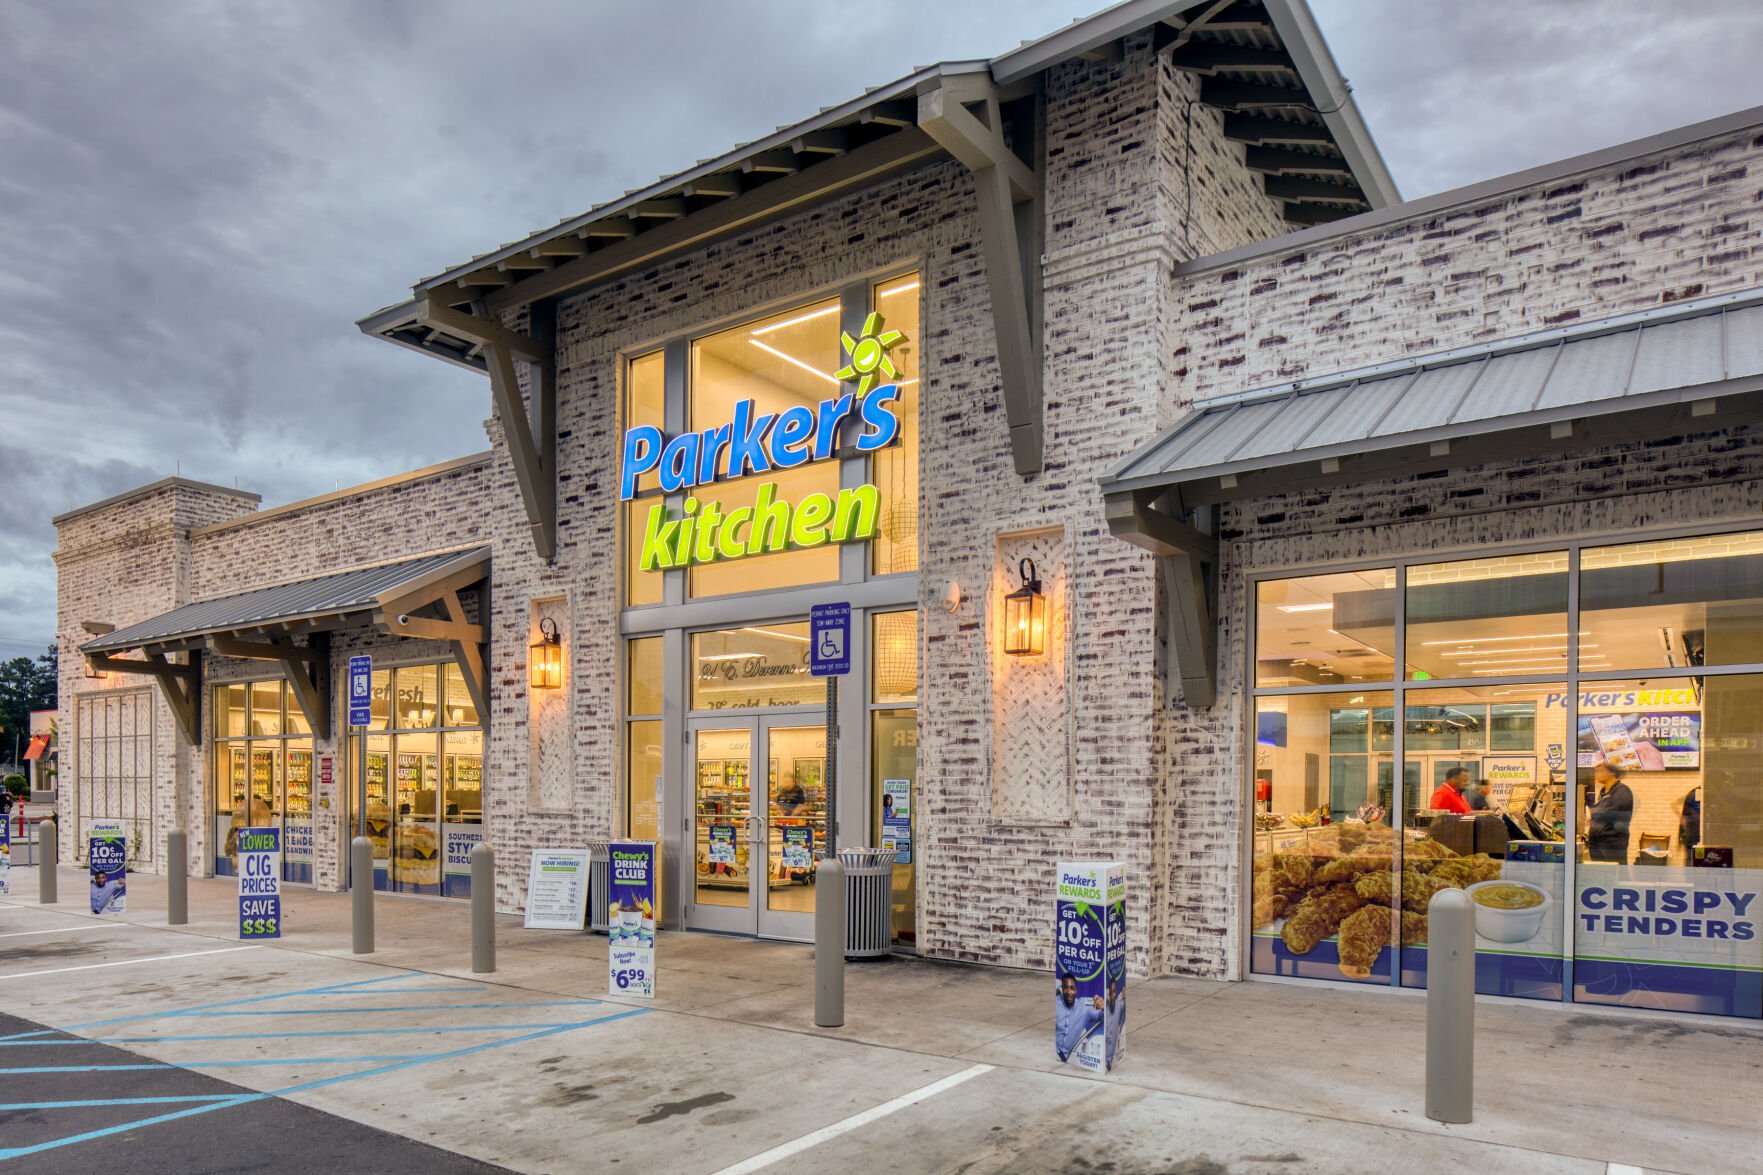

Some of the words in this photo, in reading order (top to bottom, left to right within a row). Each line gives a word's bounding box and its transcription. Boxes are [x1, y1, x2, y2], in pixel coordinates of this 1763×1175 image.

[620, 384, 901, 501] Parker's
[640, 482, 881, 572] kitchen
[371, 683, 424, 702] refesh
[1639, 716, 1690, 727] ORDER
[1639, 727, 1690, 738] AHEAD
[1669, 738, 1689, 746] APP
[286, 826, 313, 835] CHICKE
[242, 835, 275, 850] LOWER
[286, 836, 313, 846] TENDE
[286, 847, 313, 855] SANDWI
[448, 842, 474, 854] STY
[448, 856, 472, 864] BISCU
[612, 851, 649, 861] Chewy's
[246, 855, 271, 876] CIG
[614, 860, 648, 869] DRINK
[615, 868, 646, 879] CLUB
[242, 878, 276, 893] PRICES
[1062, 873, 1097, 888] Parker's
[1059, 884, 1102, 900] REWARDS
[1580, 887, 1756, 916] CRISPY
[242, 900, 275, 916] SAVE
[1062, 910, 1077, 919] GET
[1580, 914, 1755, 940] TENDERS
[1082, 937, 1102, 949] OFF
[1058, 944, 1078, 958] PER
[1079, 948, 1102, 962] GAL
[1072, 960, 1088, 968] YOUR
[1076, 1052, 1101, 1064] REGISTER
